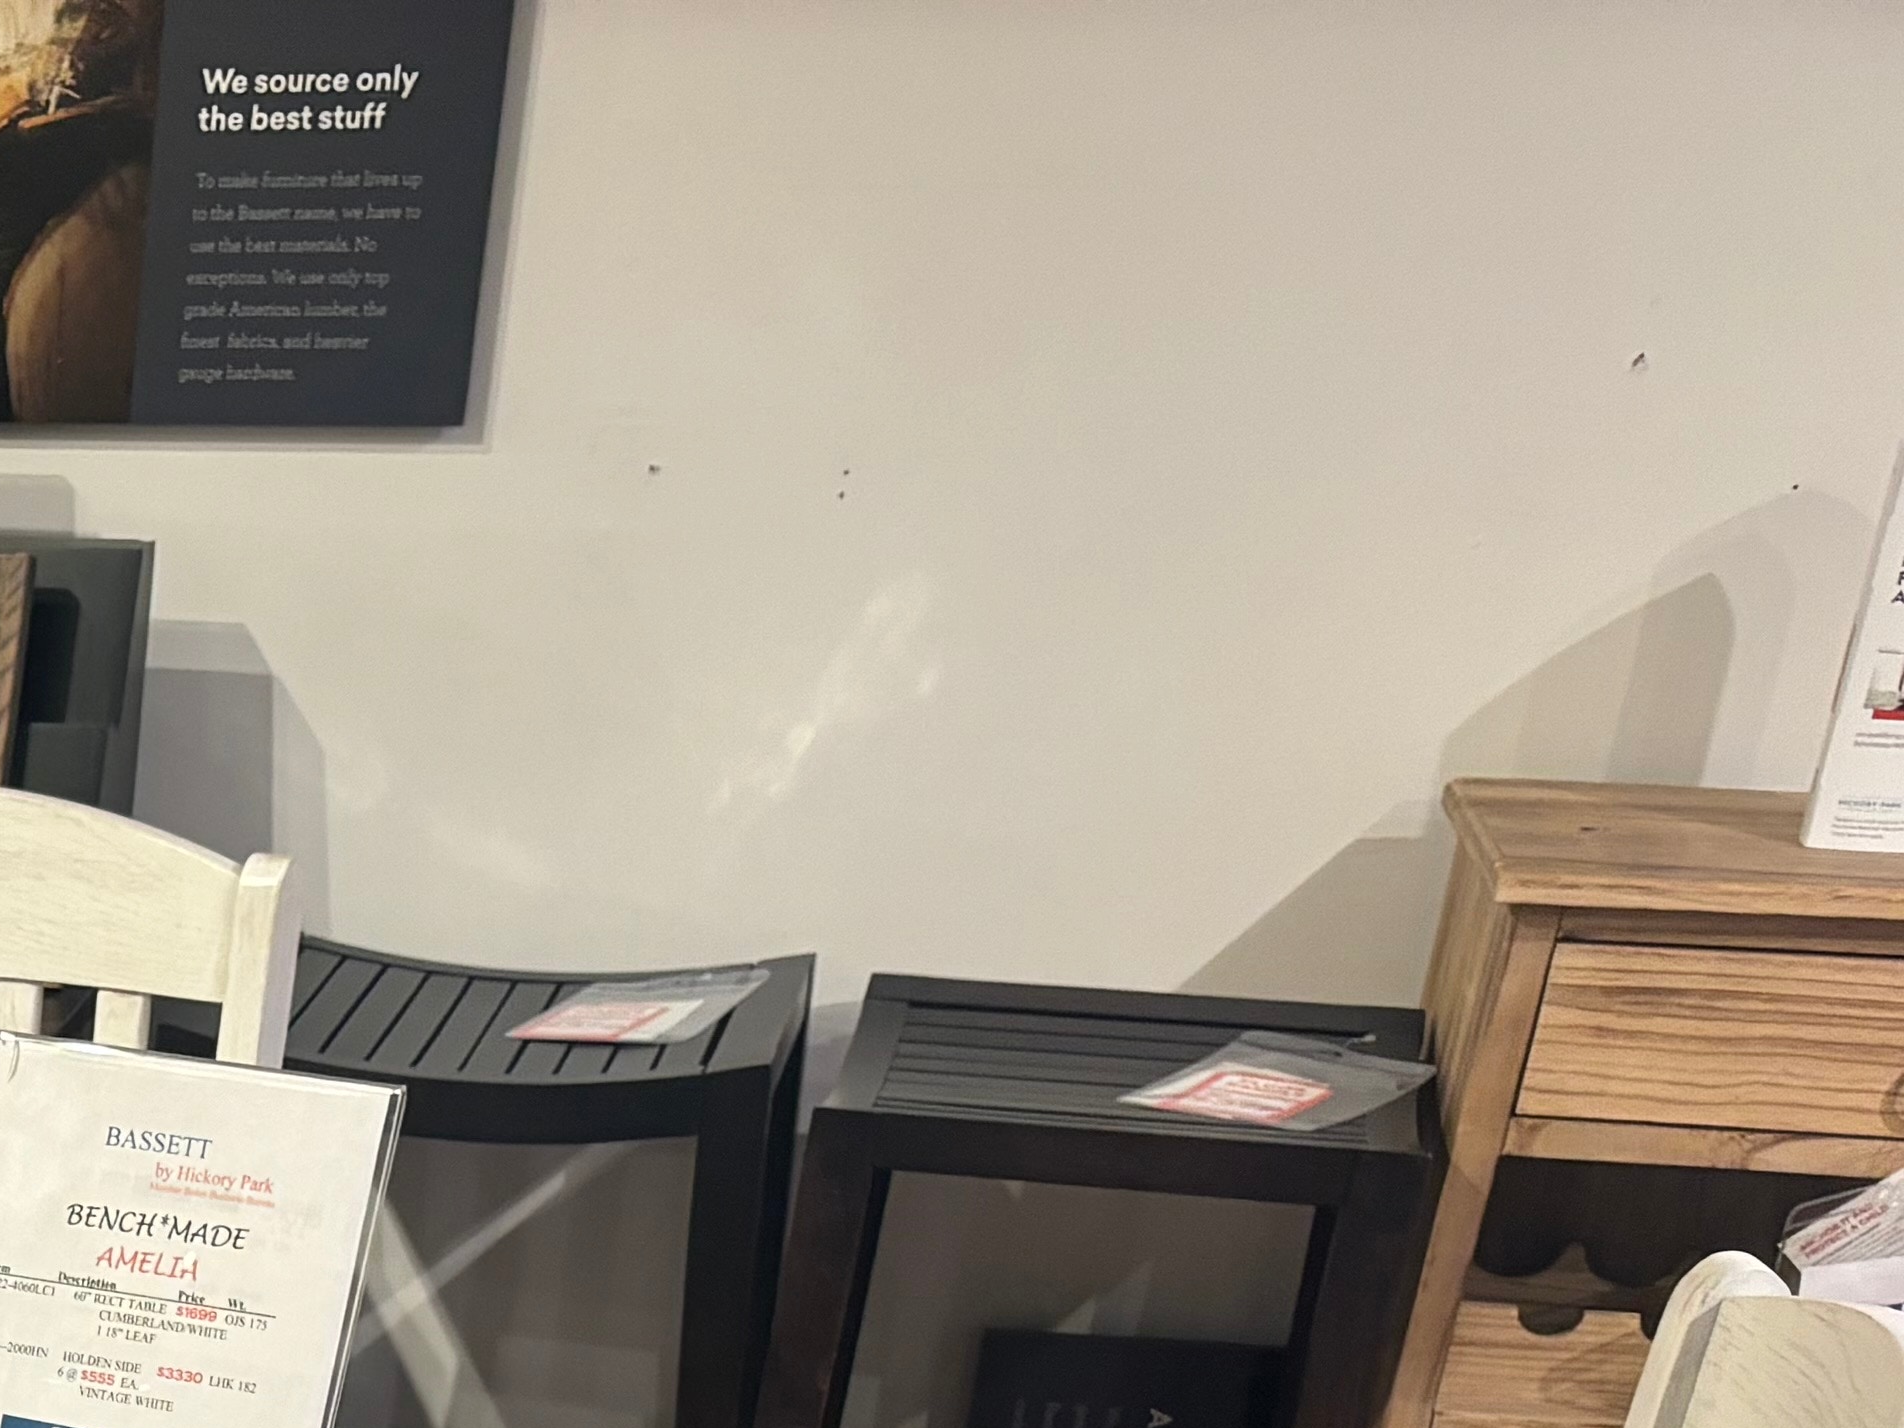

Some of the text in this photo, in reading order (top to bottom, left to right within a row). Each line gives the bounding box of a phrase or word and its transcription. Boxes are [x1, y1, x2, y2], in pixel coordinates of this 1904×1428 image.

[202, 63, 419, 99] We source only
[198, 101, 387, 132] the best stuff
[105, 1126, 212, 1159] BASSETT
[155, 1162, 273, 1194] by Hickory Park
[95, 1246, 199, 1281] AMELIA
[128, 1299, 167, 1315] TABLE
[125, 1329, 158, 1345] LEAF
[63, 1351, 113, 1370] HOLDEN
[116, 1359, 142, 1374] SIDE
[156, 1366, 203, 1384] $3330
[80, 1370, 115, 1386] $555
[79, 1385, 174, 1412] VINTAGE WHITE
[1147, 1408, 1173, 1428] A
